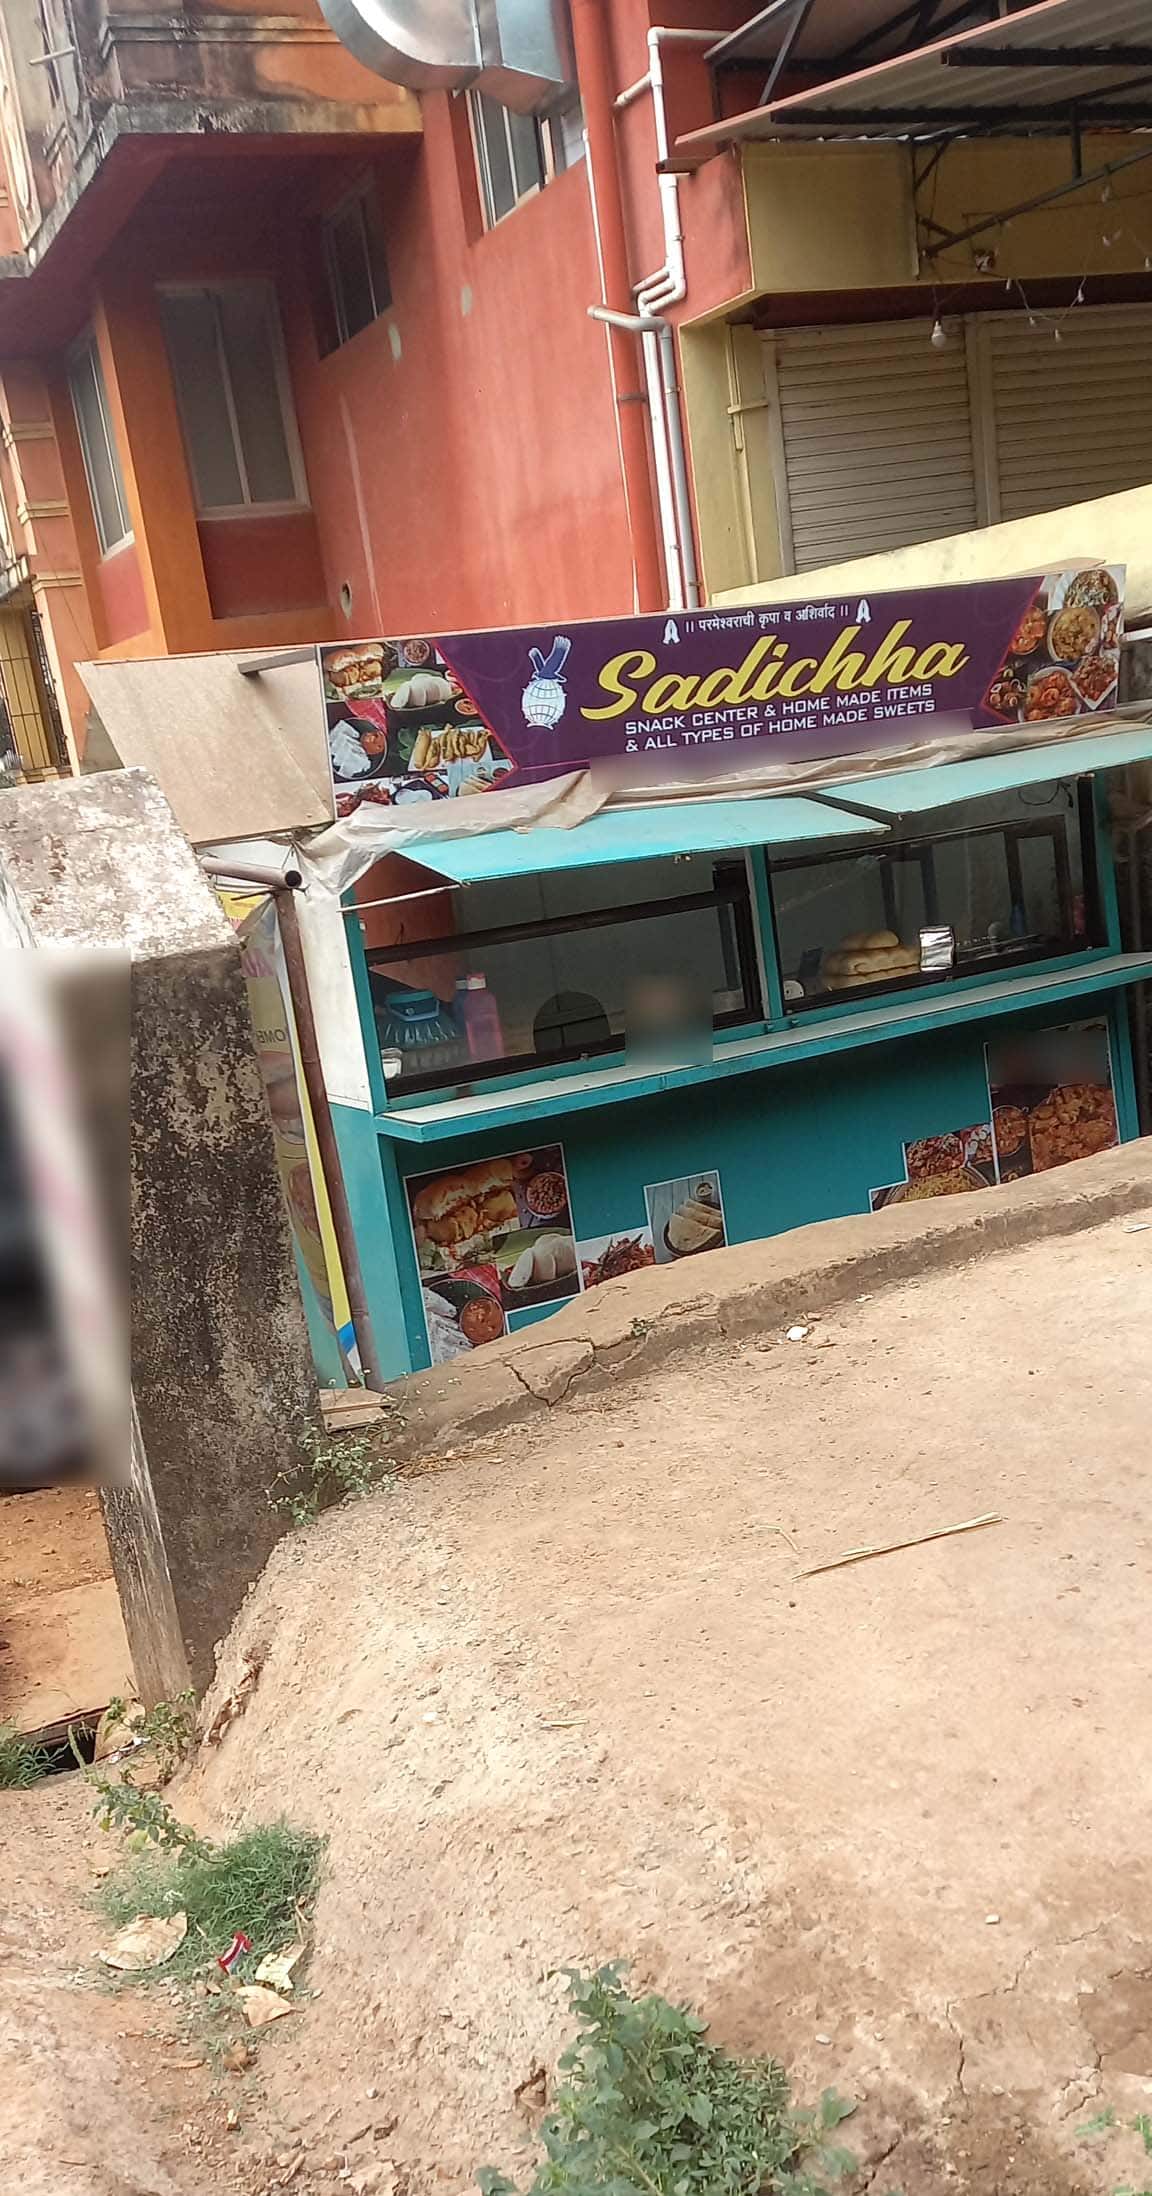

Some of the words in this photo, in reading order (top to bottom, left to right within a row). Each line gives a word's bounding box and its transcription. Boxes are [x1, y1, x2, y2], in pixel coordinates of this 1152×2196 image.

[698, 610, 755, 632] परमेश्वराची
[758, 610, 781, 630] कृपा
[783, 609, 793, 622] व
[579, 619, 971, 721] Sadichha
[625, 715, 686, 735] SNACK
[692, 706, 759, 726] CENTER
[764, 704, 777, 717] &
[782, 696, 831, 715] HOME
[836, 690, 881, 707] MADE
[887, 683, 933, 700] ITEMS
[625, 739, 639, 753] &
[644, 734, 678, 751] ALL
[681, 726, 735, 746] TYPES
[740, 722, 764, 738] OF
[768, 715, 817, 734] HOME
[823, 708, 868, 727] MADE
[873, 699, 936, 719] SWEETS
